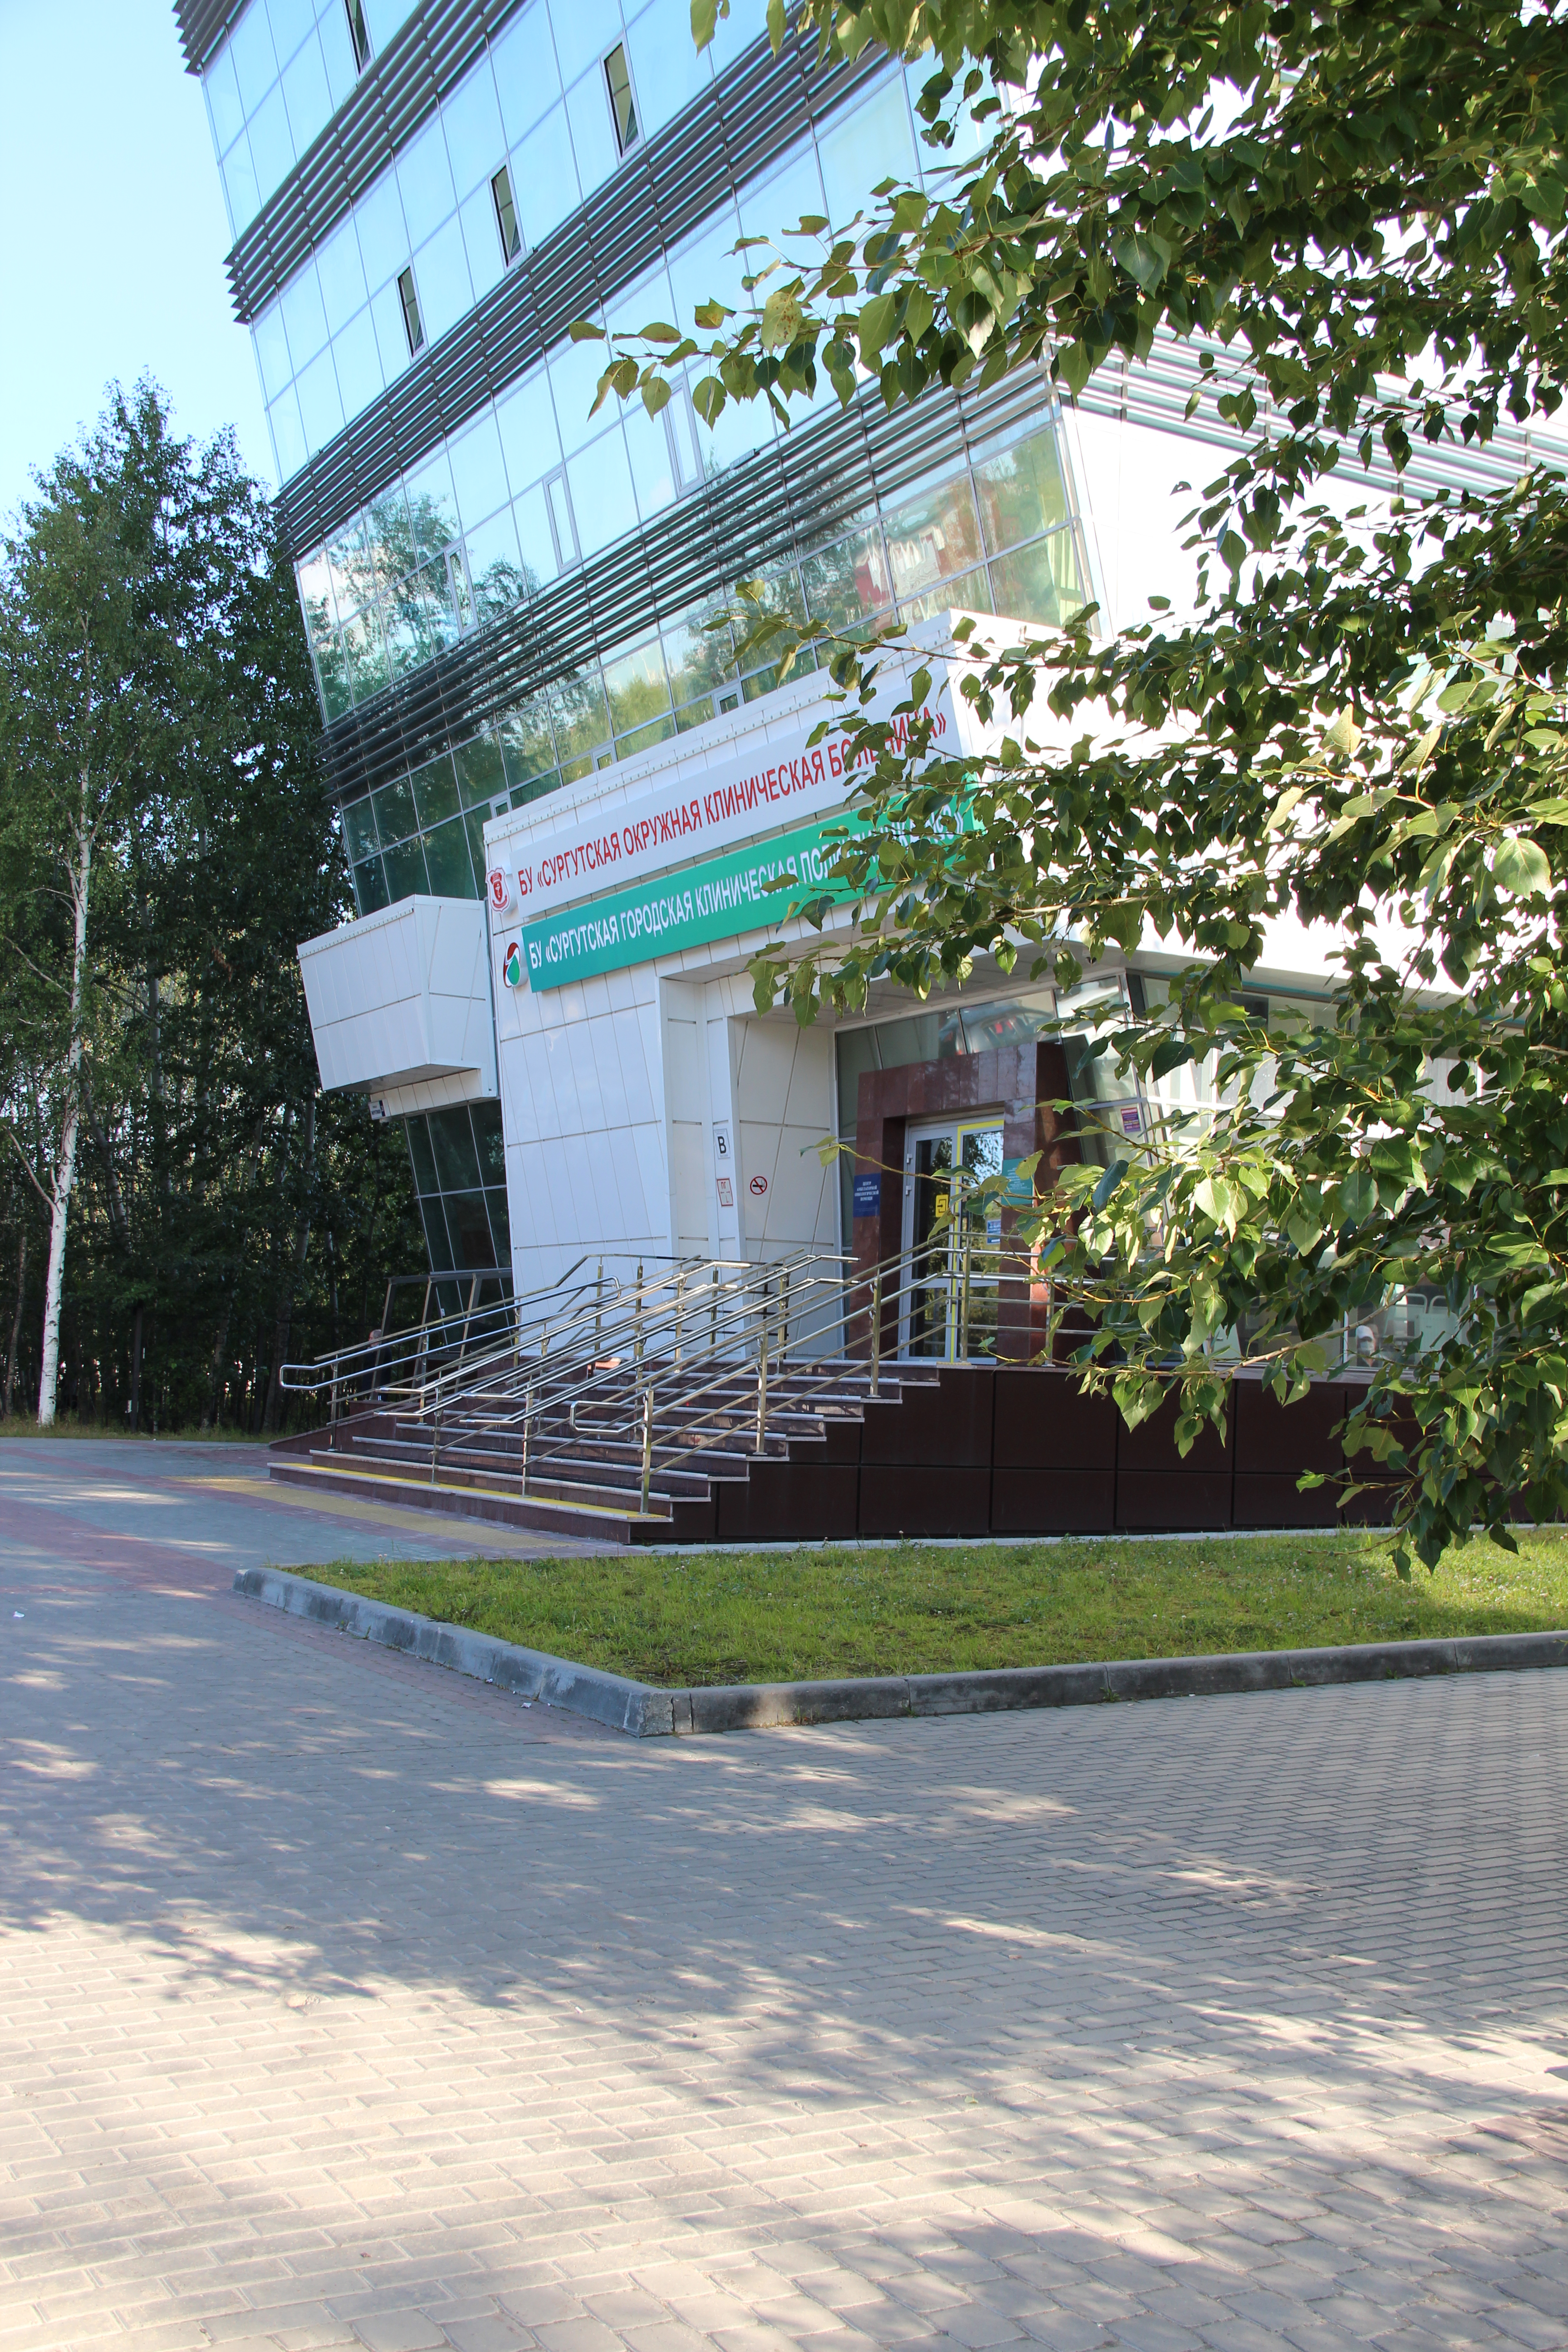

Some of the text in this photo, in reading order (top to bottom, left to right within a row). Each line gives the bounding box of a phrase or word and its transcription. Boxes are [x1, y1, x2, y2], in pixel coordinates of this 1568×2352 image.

[518, 865, 534, 897] БУ
[537, 832, 622, 889] «СУРГУТСКАЯ
[623, 800, 703, 856] ОКРУЖНАЯ
[703, 750, 826, 826] КЛИНИЧЕСКАЯ
[529, 940, 543, 969] БУ
[545, 916, 619, 964] «СУРГУТСКАЯ
[620, 890, 694, 937] ГОРОДСКАЯ
[695, 855, 799, 918] КЛИНИЧЕСКАЯ
